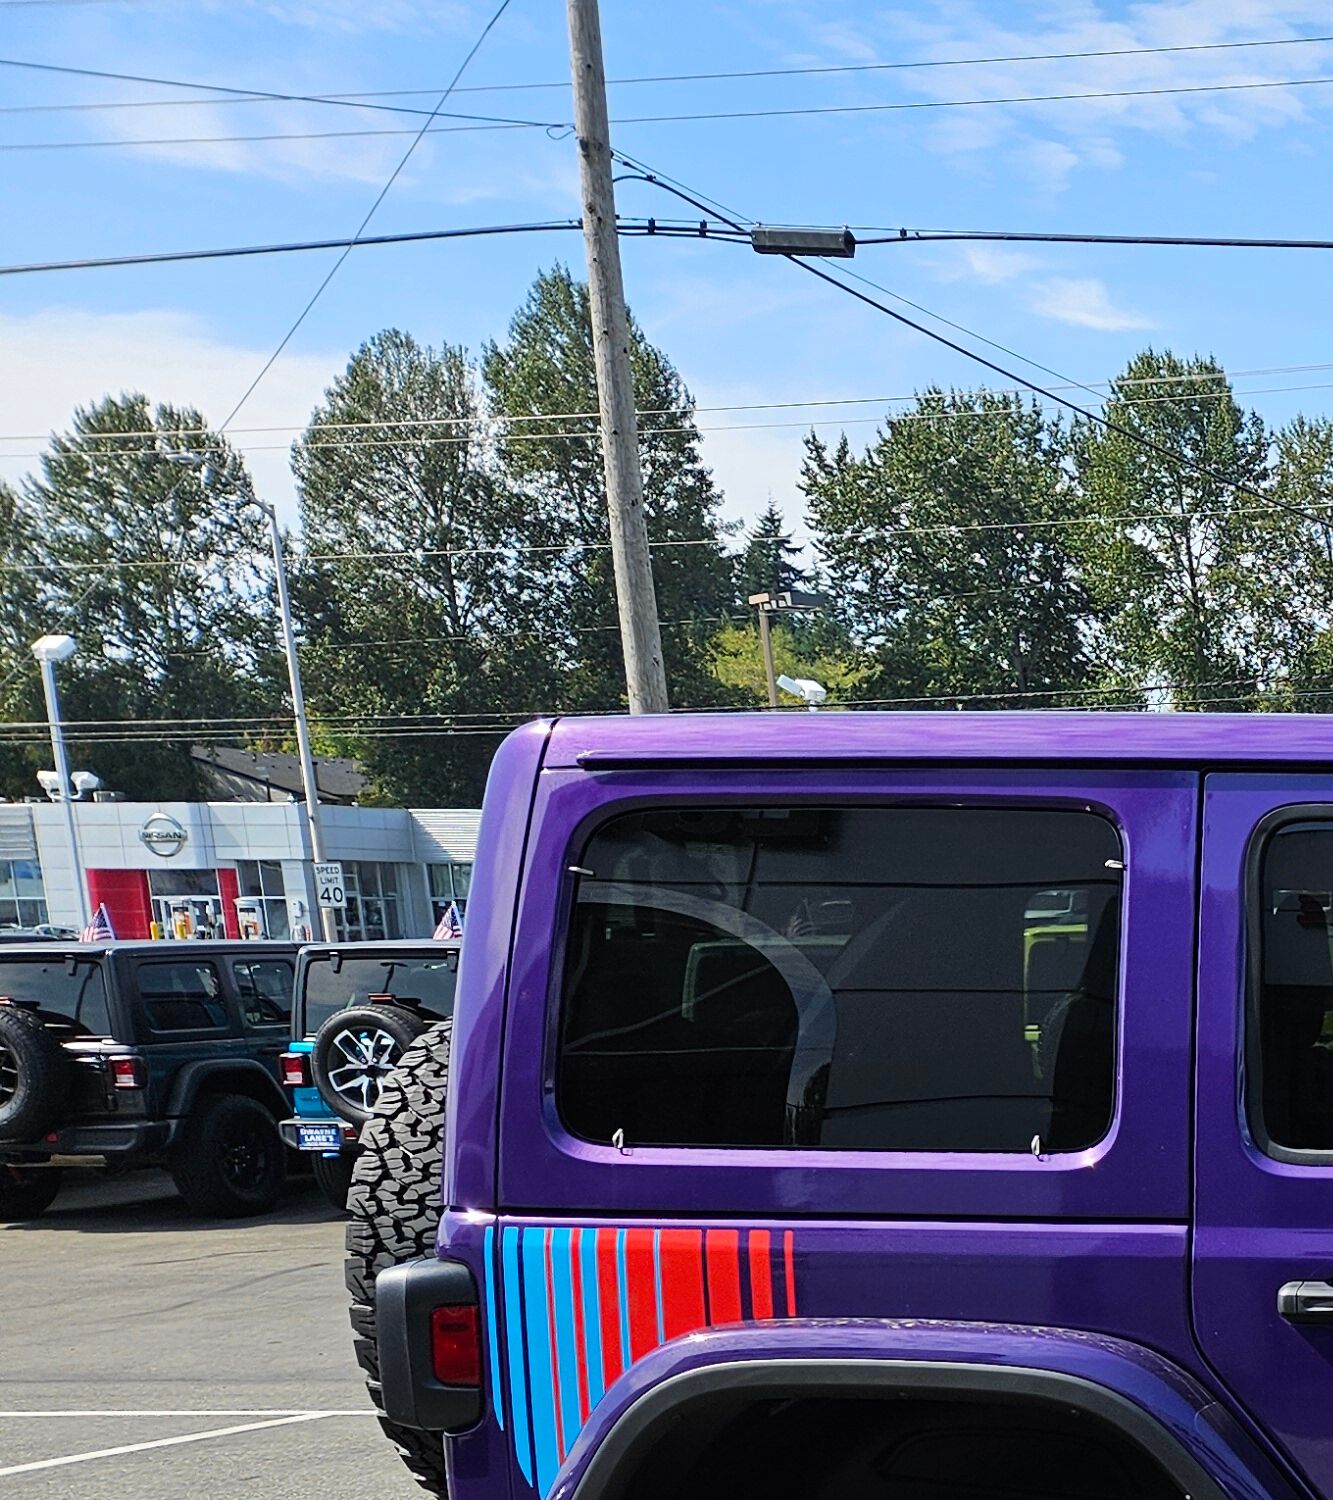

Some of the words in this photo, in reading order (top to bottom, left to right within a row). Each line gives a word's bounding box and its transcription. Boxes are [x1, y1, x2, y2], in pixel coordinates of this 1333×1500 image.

[141, 831, 183, 840] NISSAN
[316, 866, 340, 875] SPEED
[320, 875, 340, 884] LIMIT
[320, 886, 343, 903] 40
